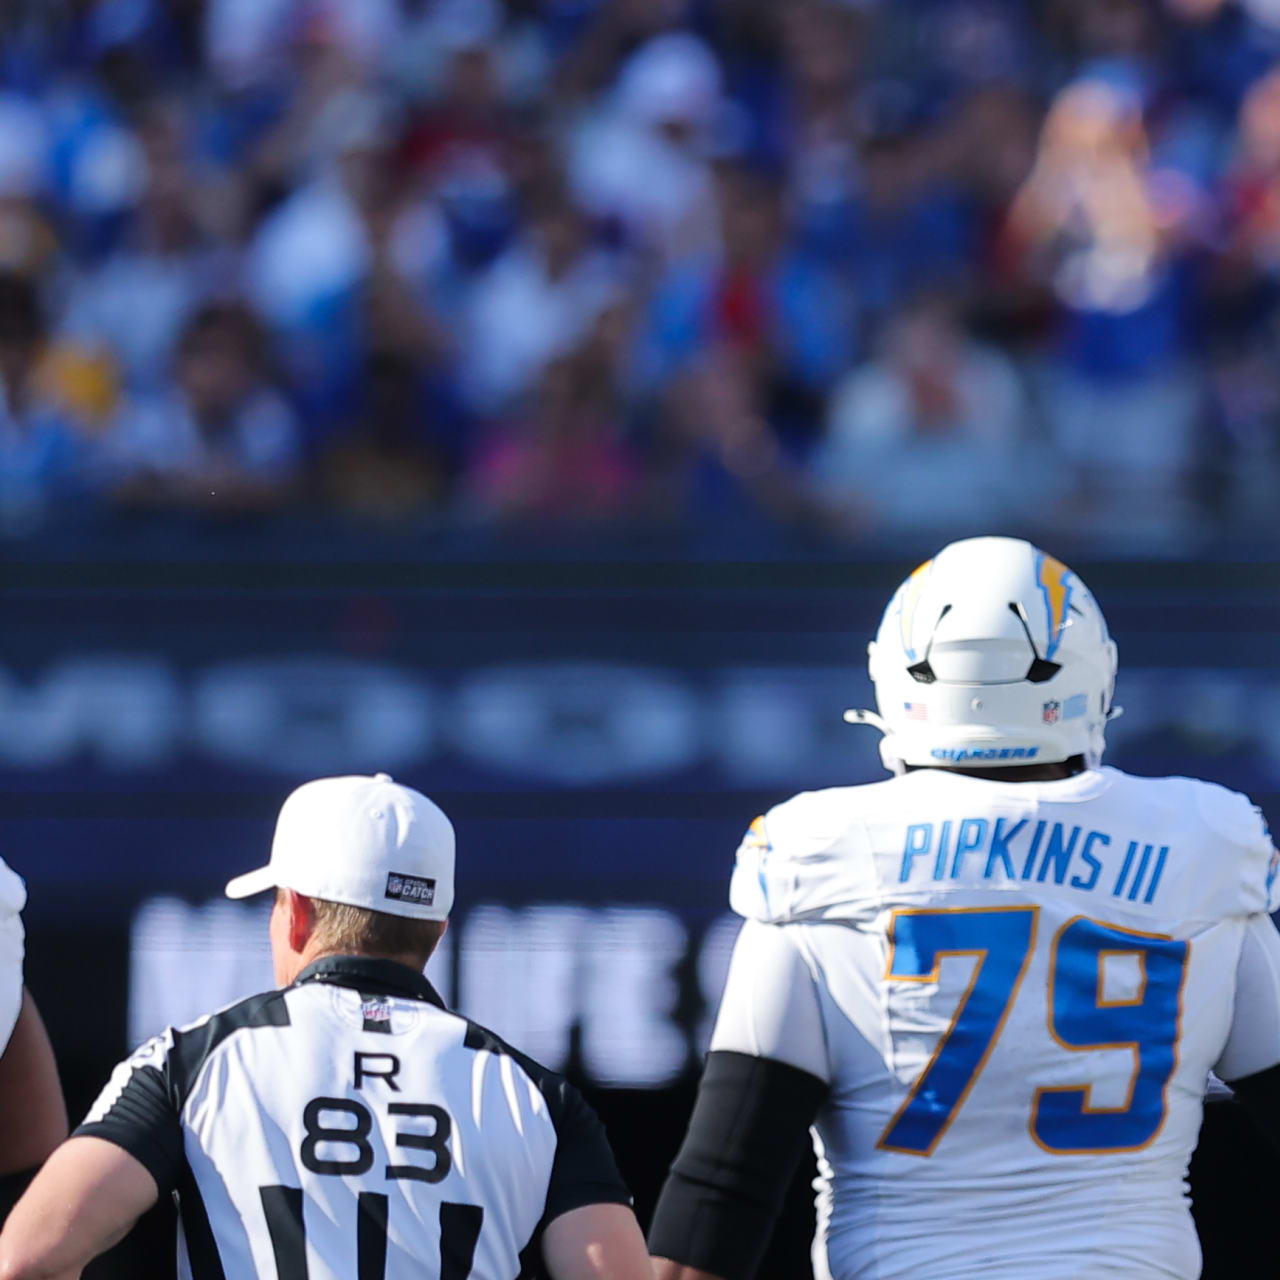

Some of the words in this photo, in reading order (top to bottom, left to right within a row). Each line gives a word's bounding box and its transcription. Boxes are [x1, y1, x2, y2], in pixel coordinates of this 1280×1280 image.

[931, 747, 1040, 763] CHARGERS
[899, 818, 1110, 890] PIPKINS
[1112, 840, 1169, 904] III
[354, 1051, 402, 1092] R
[876, 904, 1191, 1157] 79
[300, 1096, 452, 1185] 83
